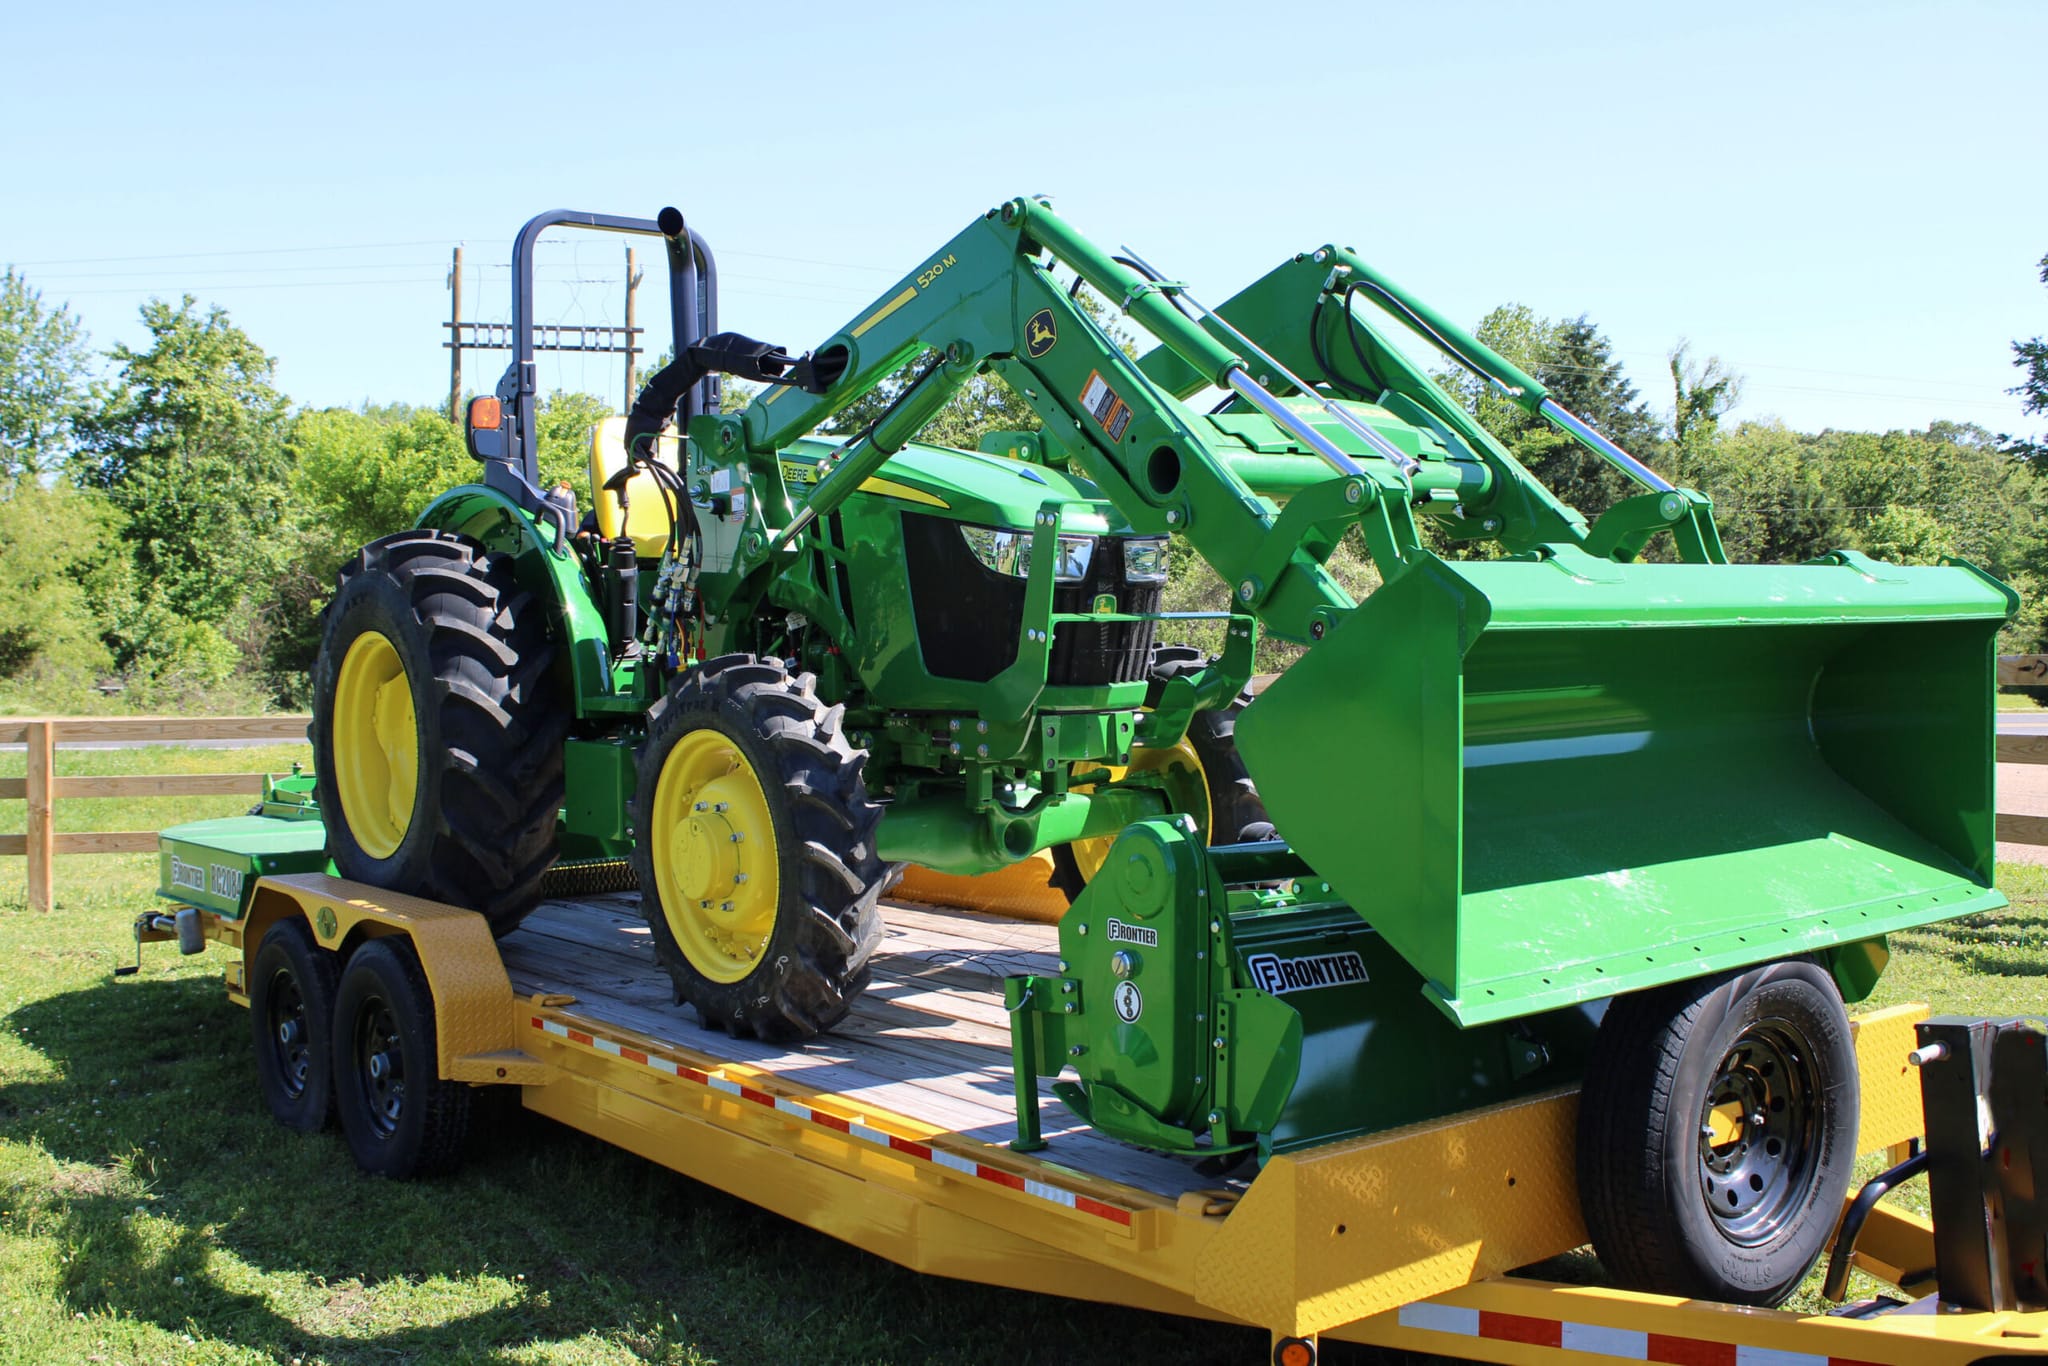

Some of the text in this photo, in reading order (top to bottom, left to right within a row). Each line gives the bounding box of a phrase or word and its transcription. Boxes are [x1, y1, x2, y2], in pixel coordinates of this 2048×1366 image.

[916, 253, 957, 289] 520 M
[782, 464, 809, 481] DEERE
[171, 856, 205, 891] FRONTIER
[211, 863, 243, 900] RC2084
[1108, 919, 1157, 947] FRONTIER
[1250, 953, 1369, 995] FRONTIER
